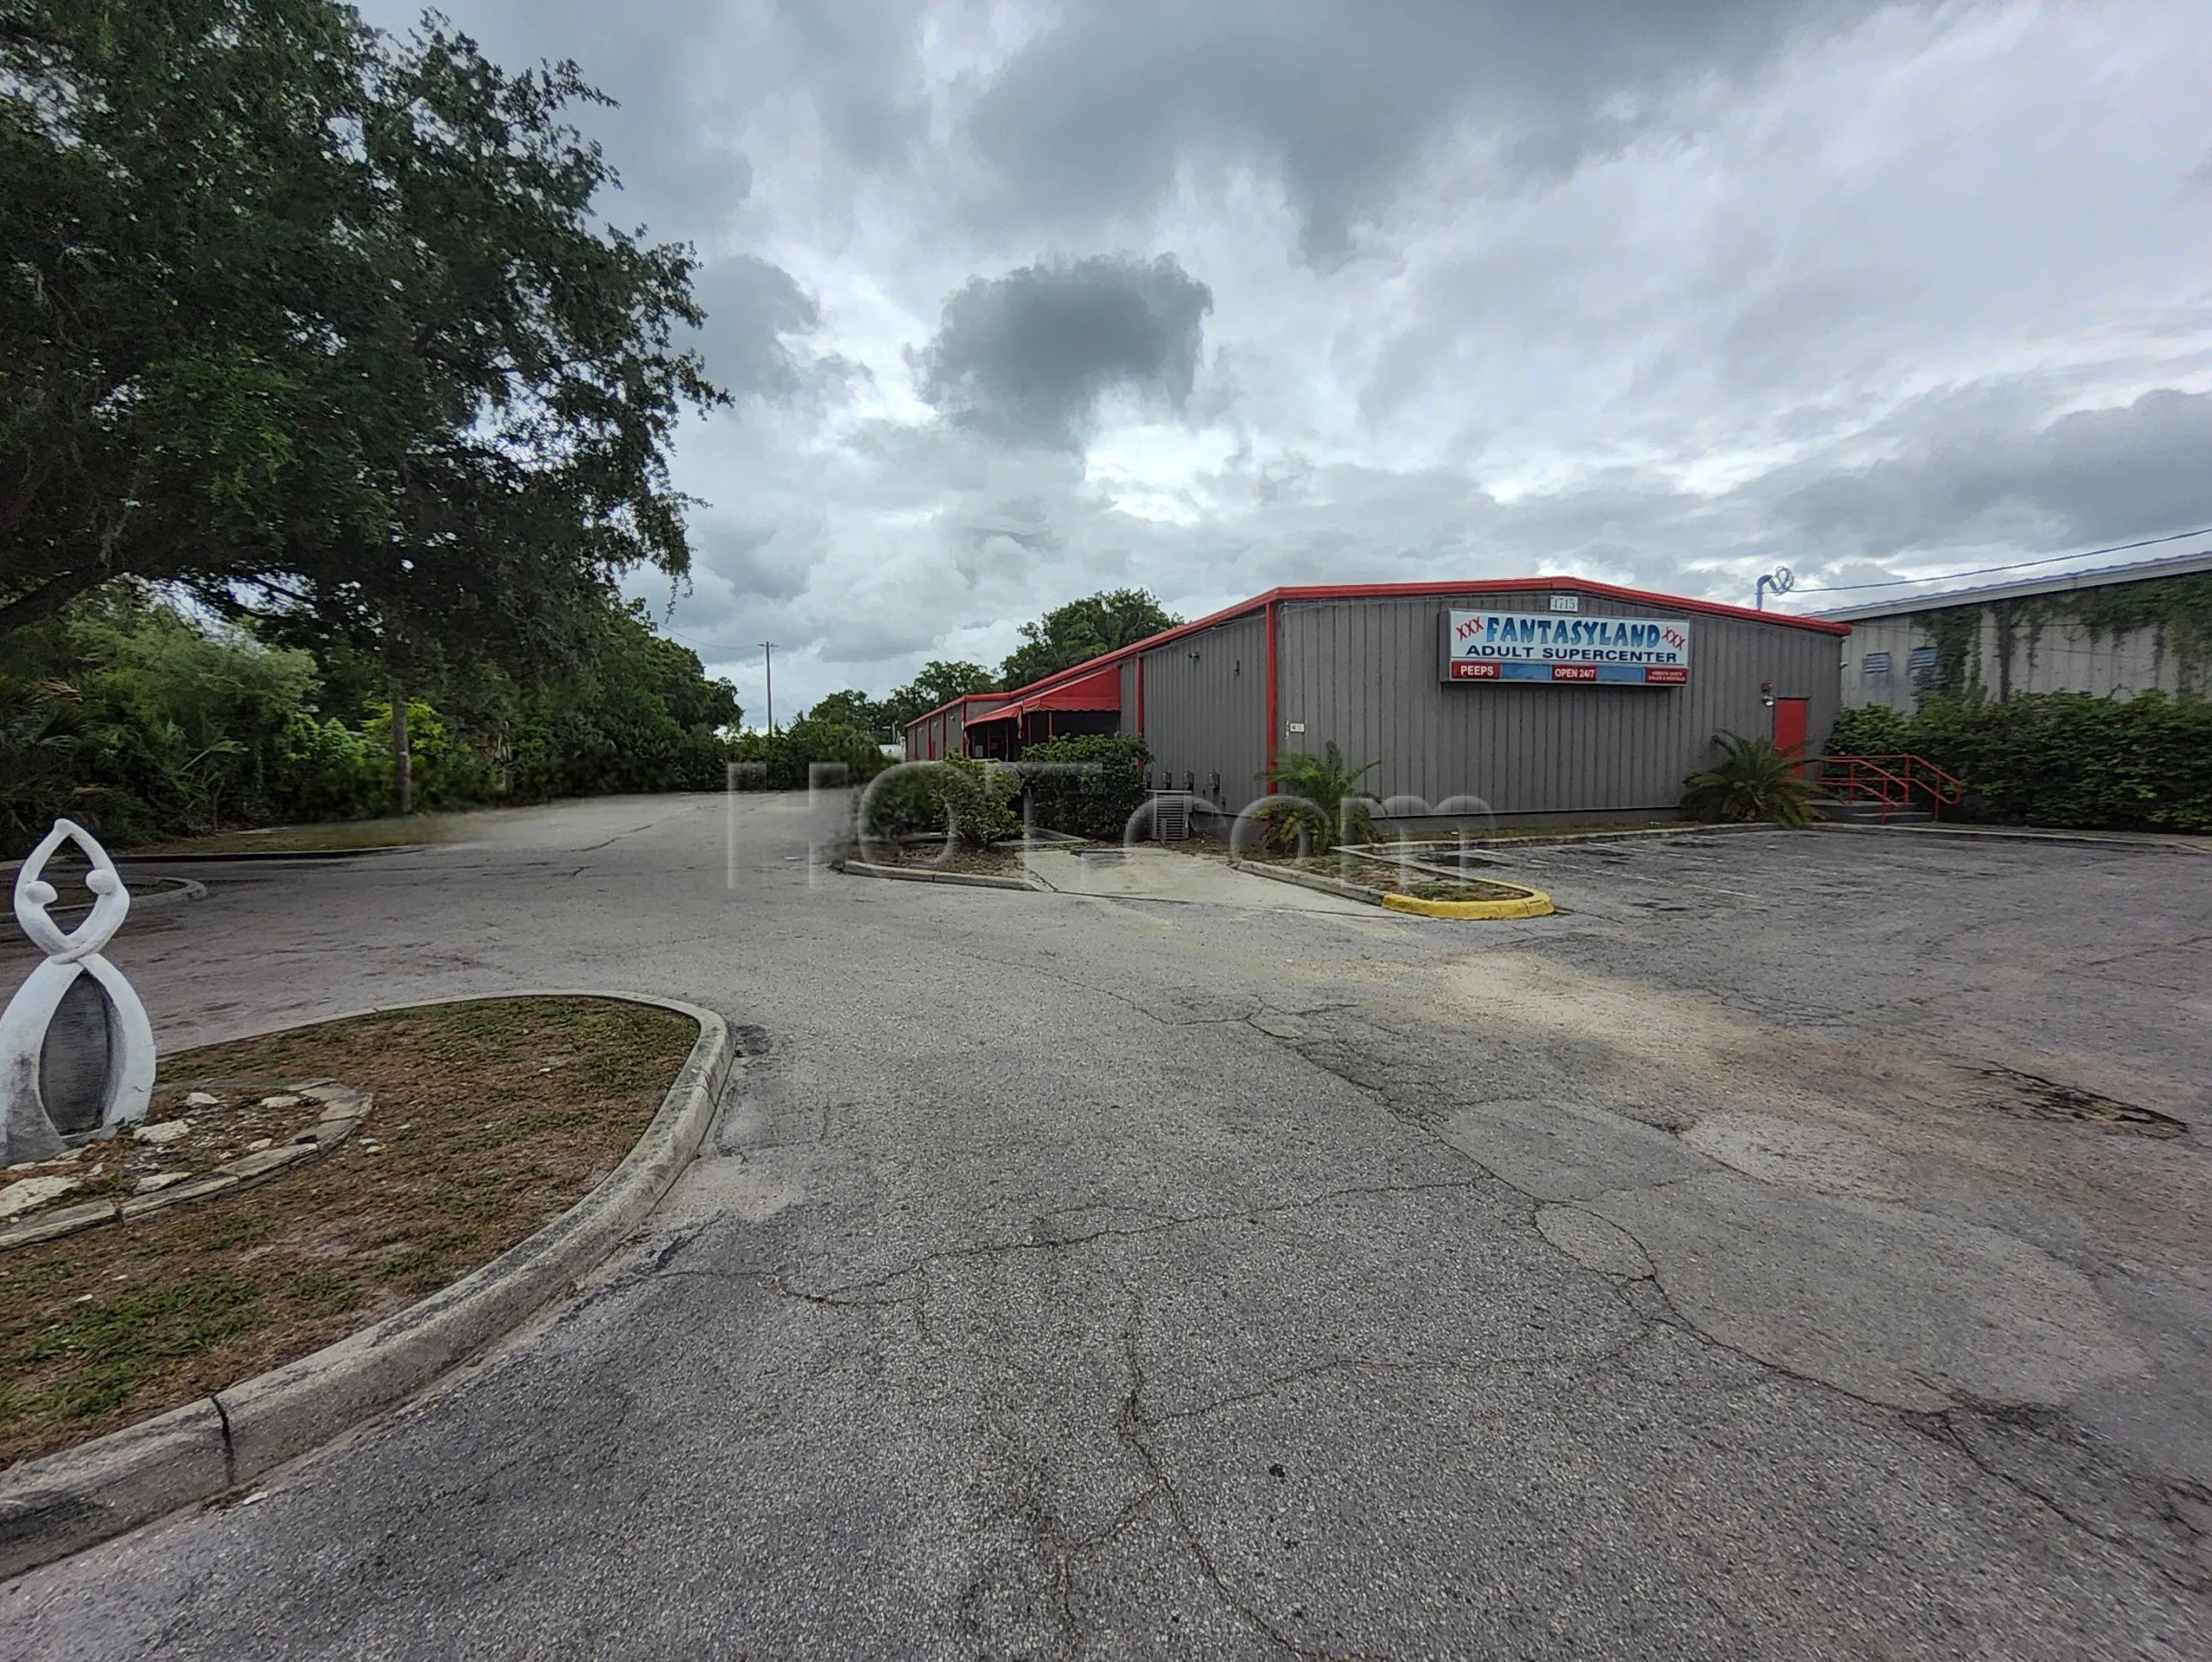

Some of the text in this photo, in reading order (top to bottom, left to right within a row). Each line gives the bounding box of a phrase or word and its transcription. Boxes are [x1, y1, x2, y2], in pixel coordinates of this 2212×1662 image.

[1456, 616, 1686, 651] XXX FANTASYLAND XXX
[1465, 645, 1676, 663] ADULT SUPERCENTER
[1460, 665, 1494, 676] PEEPS
[1554, 668, 1595, 678] OPEN 24/7
